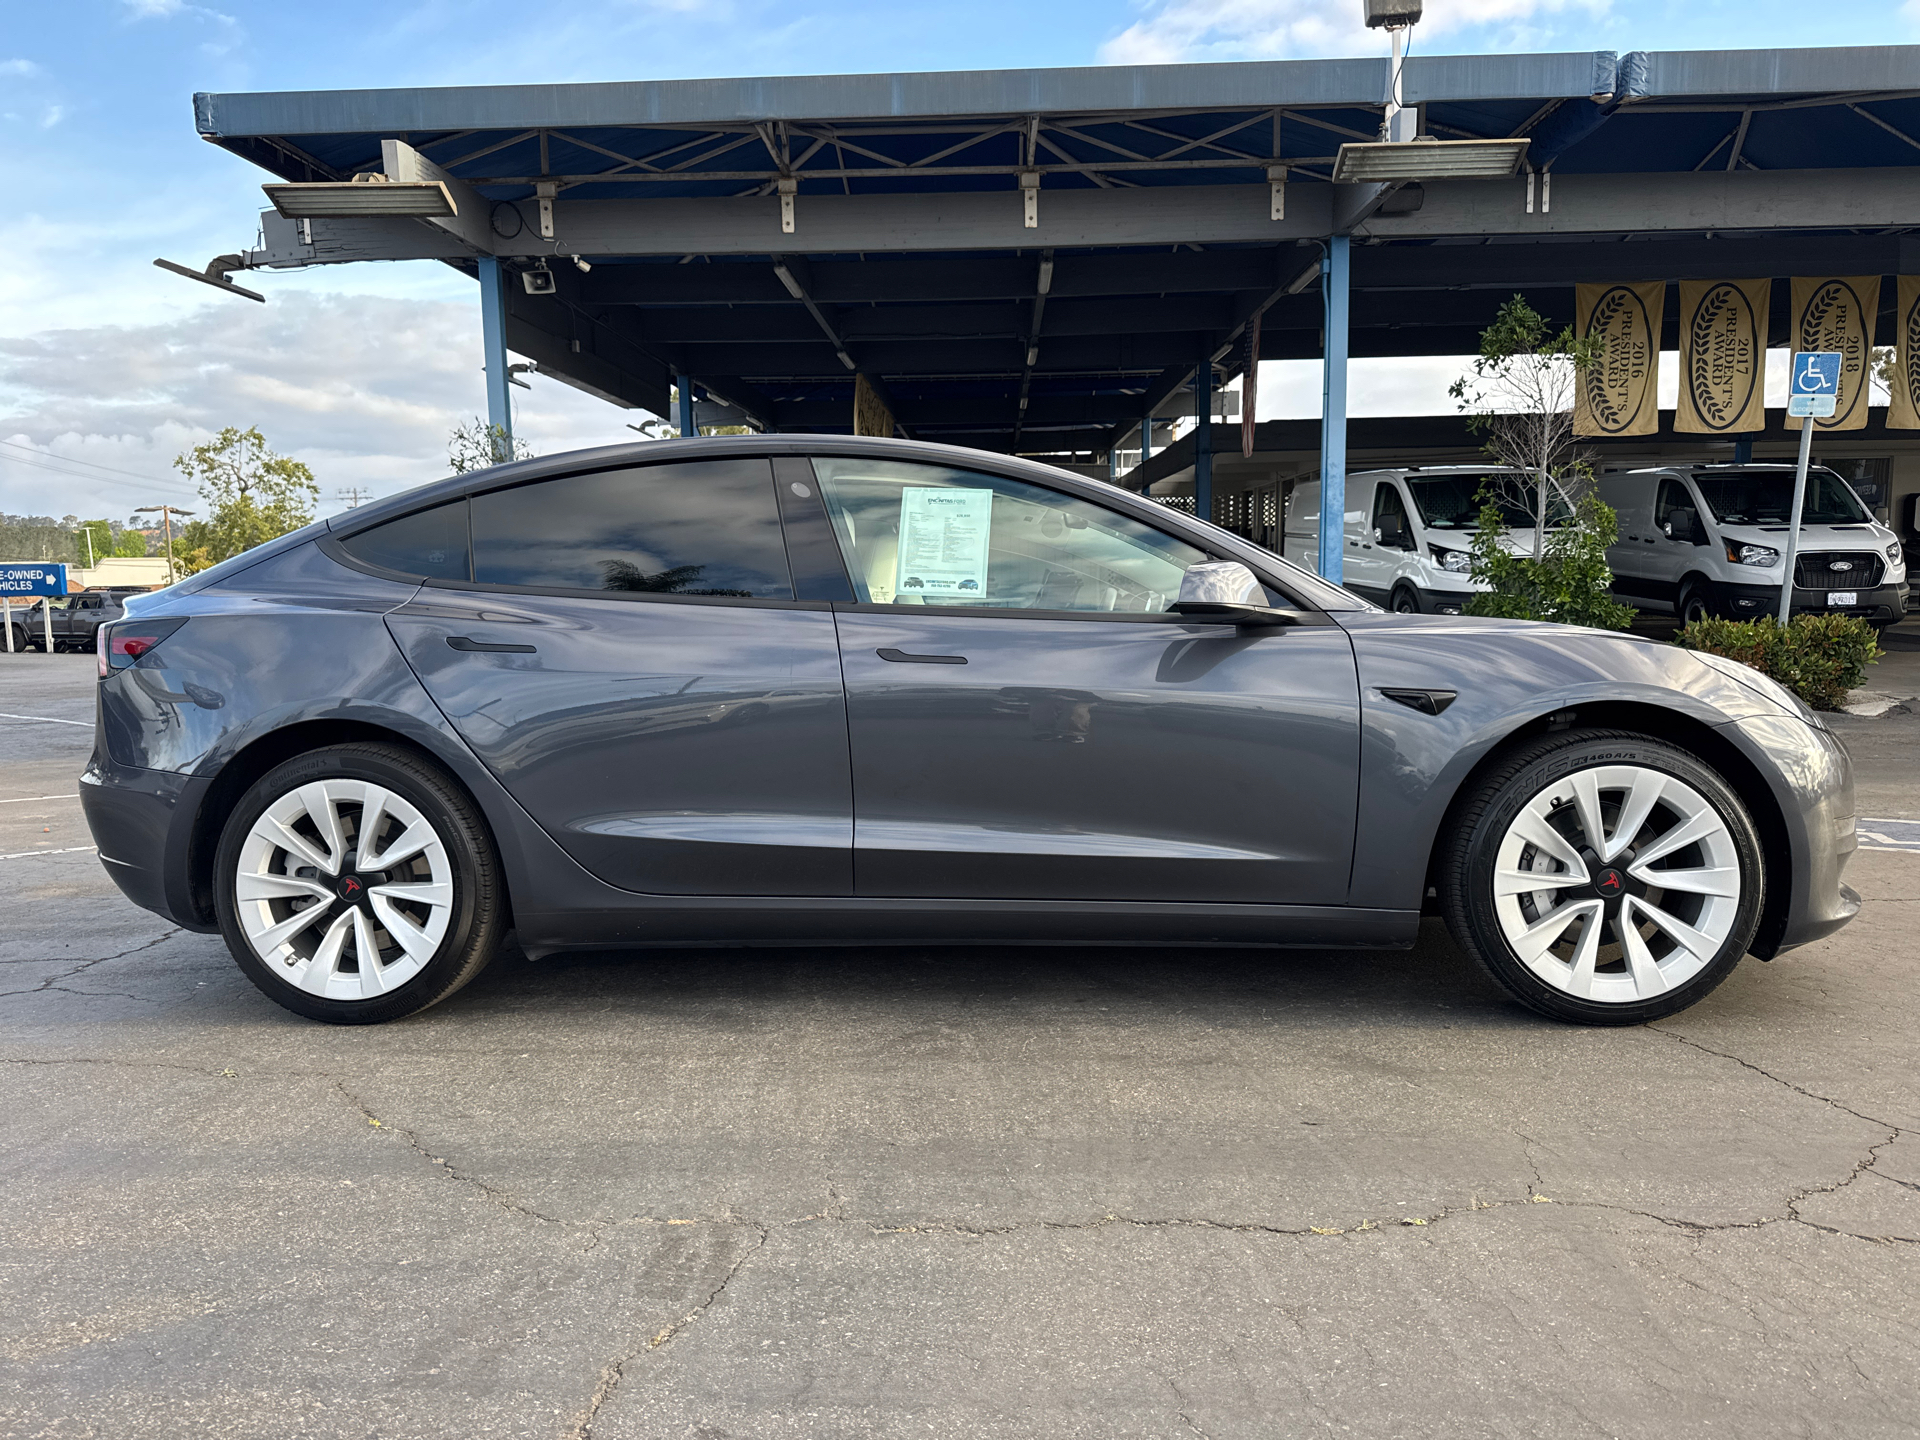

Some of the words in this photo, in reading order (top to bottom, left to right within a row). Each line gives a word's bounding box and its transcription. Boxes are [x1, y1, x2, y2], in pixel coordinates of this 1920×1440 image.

[1607, 333, 1620, 389] AWARD
[1616, 310, 1633, 412] PRESIDENT'S
[1631, 341, 1645, 379] 2016
[1712, 329, 1725, 386] AWARD
[1722, 307, 1738, 409] PRESIDENT'S
[1736, 338, 1750, 375] 2017
[1845, 335, 1859, 373] 2018
[0, 570, 44, 580] E-OWNED
[0, 581, 33, 591] HICLES
[269, 759, 320, 788] Continental
